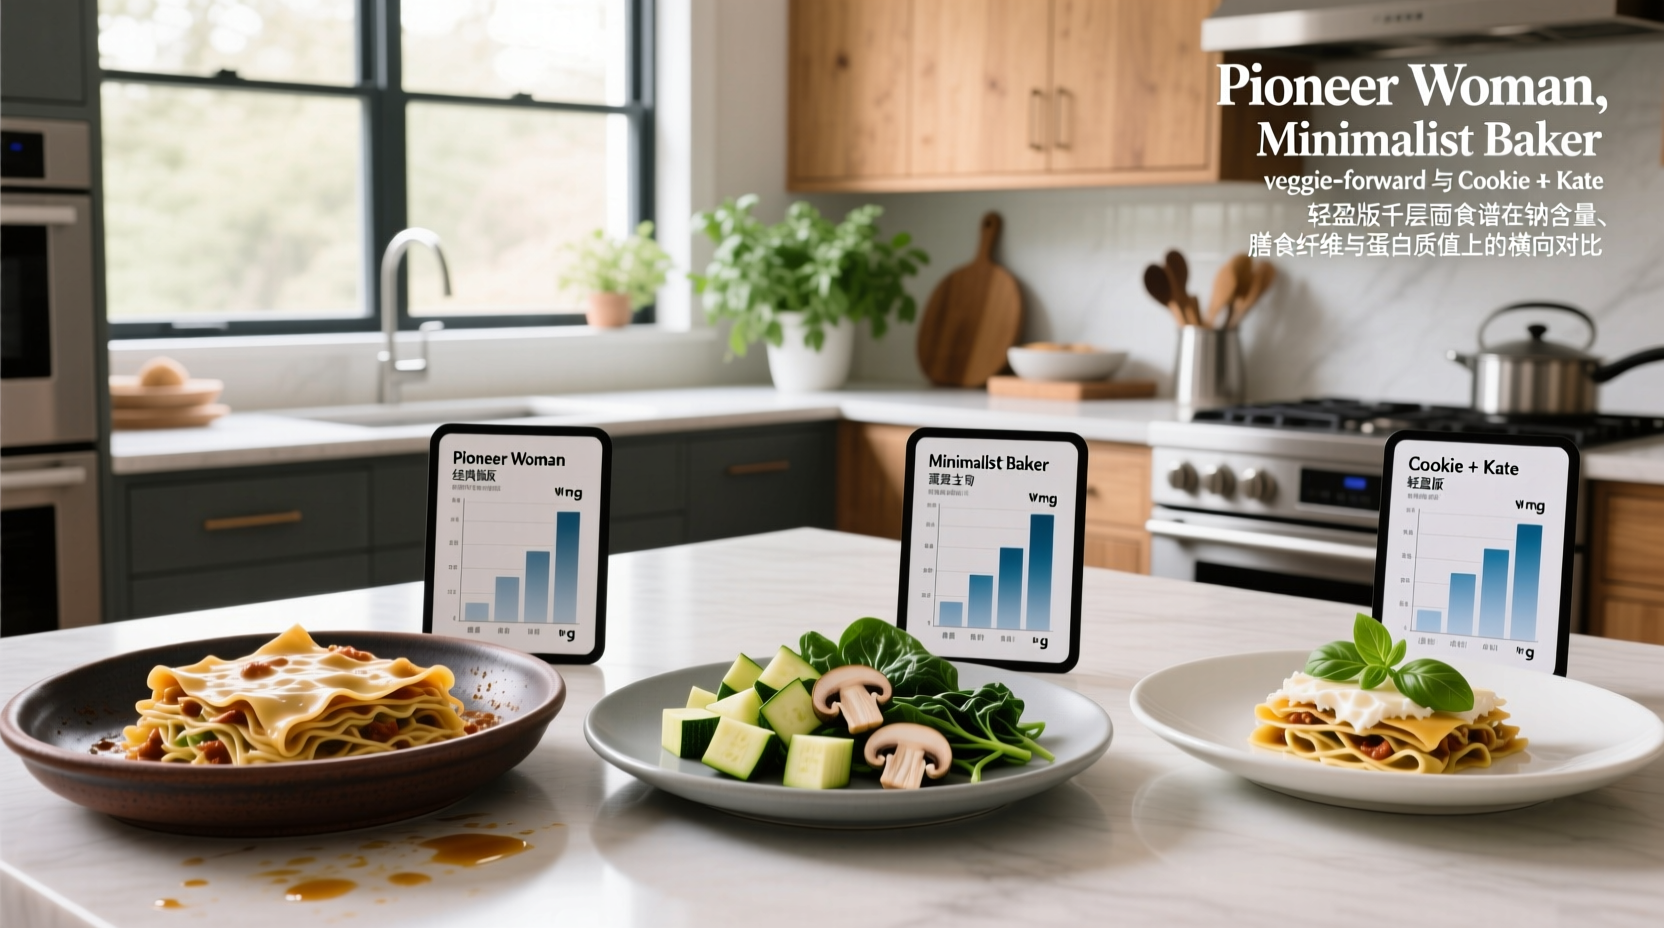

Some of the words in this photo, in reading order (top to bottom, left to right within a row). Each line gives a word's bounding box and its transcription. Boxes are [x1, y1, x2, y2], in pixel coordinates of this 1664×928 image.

[453, 450, 508, 466] Pioneer
[510, 451, 566, 467] Woman
[1006, 454, 1050, 472] Baker
[1408, 456, 1464, 474] Cookie
[1468, 461, 1479, 473] +
[1483, 459, 1519, 476] Kate
